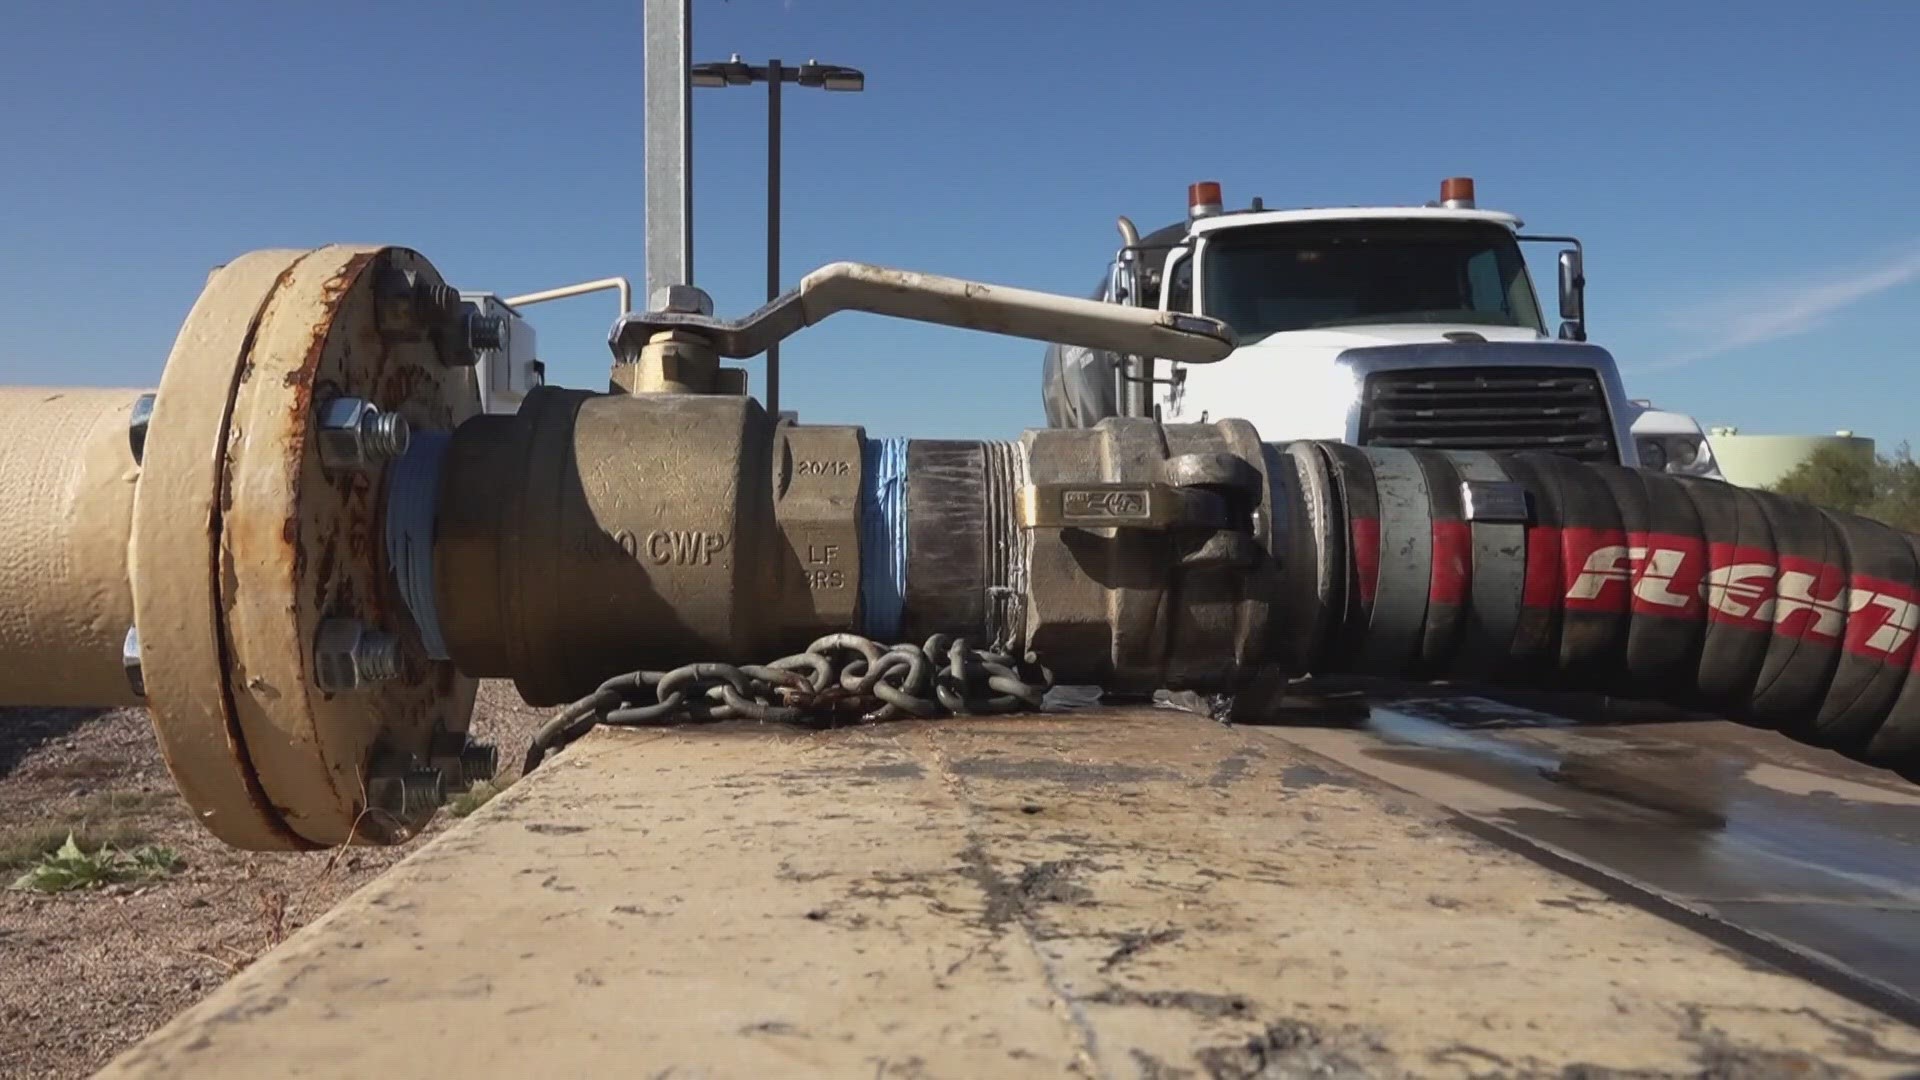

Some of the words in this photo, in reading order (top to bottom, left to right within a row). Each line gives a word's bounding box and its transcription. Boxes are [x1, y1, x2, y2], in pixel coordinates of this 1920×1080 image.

[799, 460, 850, 475] 20/12
[646, 529, 724, 566] CWP
[809, 545, 839, 565] LF
